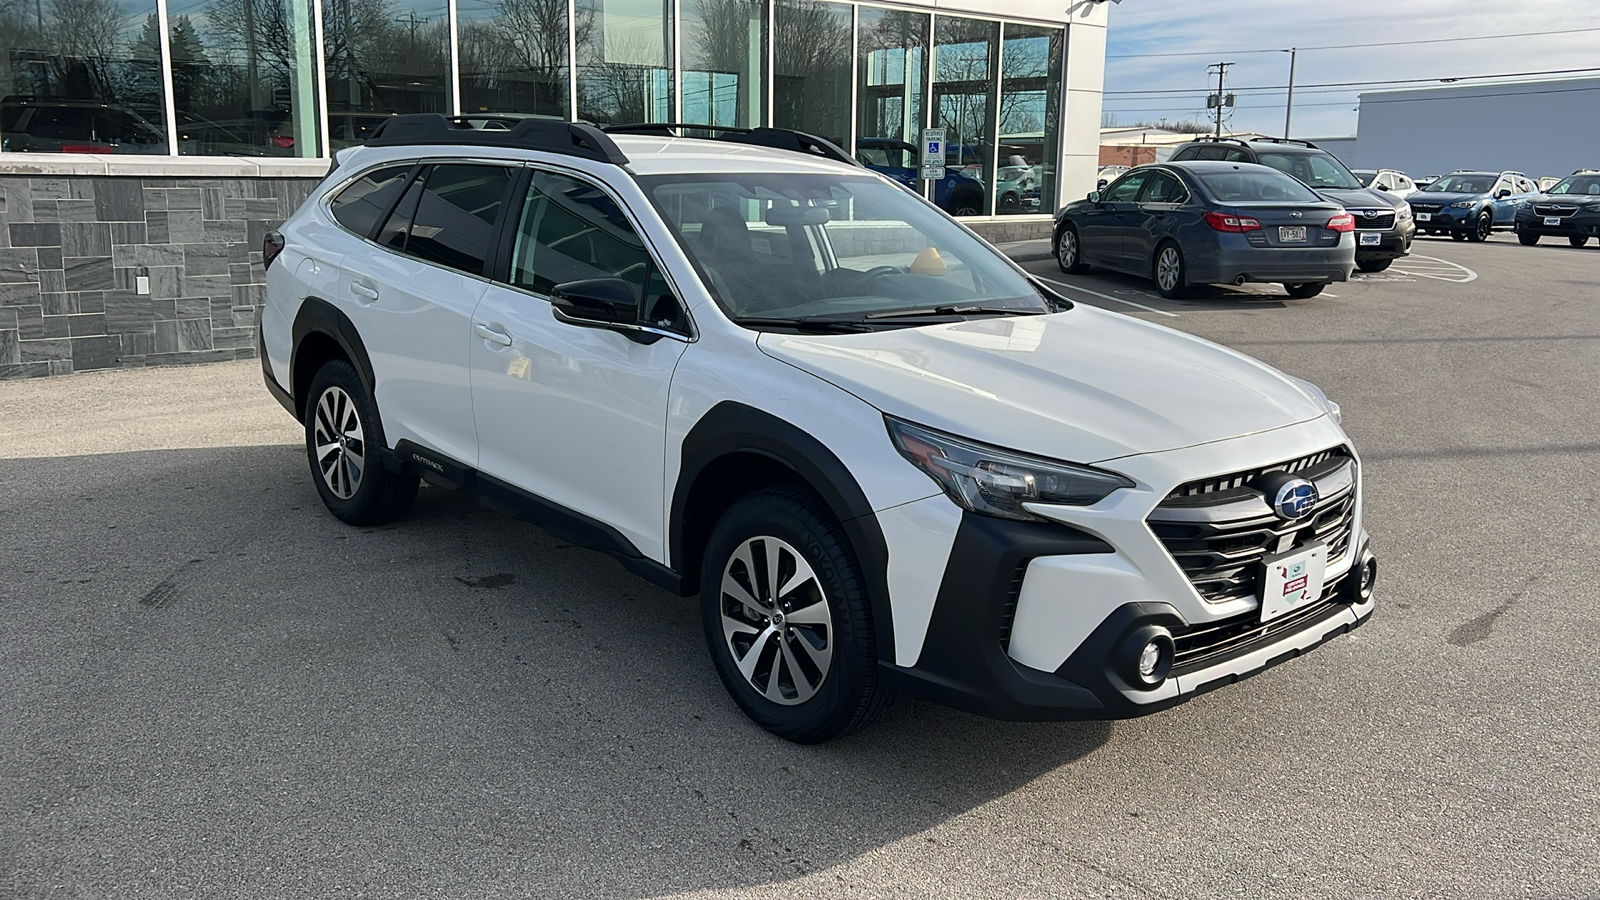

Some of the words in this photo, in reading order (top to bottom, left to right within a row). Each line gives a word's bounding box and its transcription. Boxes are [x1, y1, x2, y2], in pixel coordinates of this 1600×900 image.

[412, 453, 444, 472] OUTBACK
[806, 533, 851, 638] YOKOHAMA
[1285, 582, 1306, 593] PRE-OWNED
[1287, 578, 1304, 588] CERTIFIED
